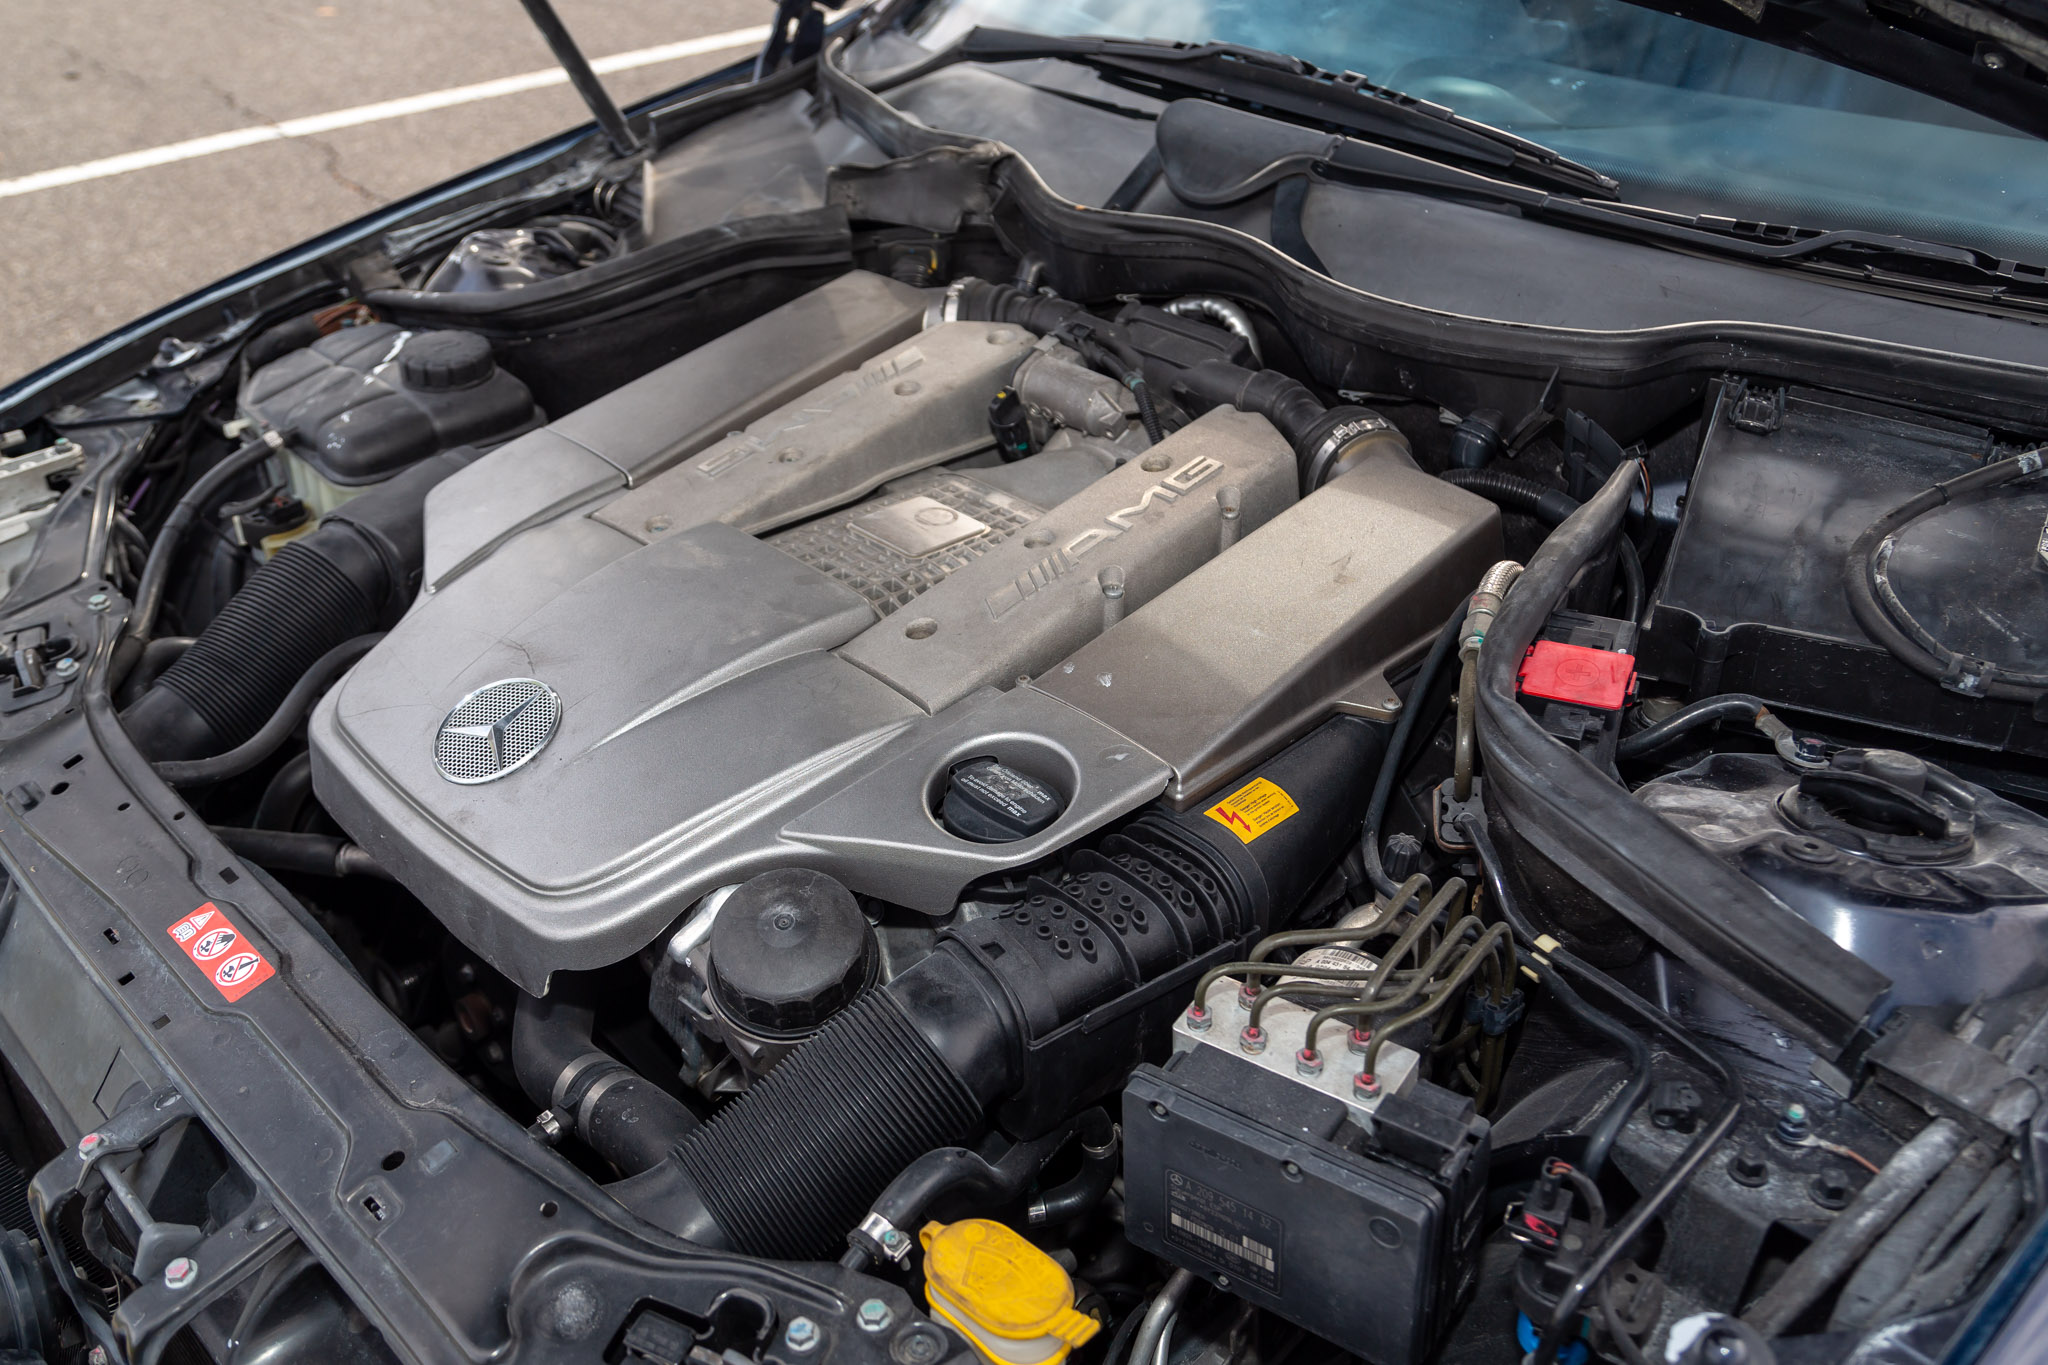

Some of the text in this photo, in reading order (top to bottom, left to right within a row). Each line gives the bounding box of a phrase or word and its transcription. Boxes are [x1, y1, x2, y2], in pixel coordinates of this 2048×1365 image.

[1058, 455, 1225, 568] AMG
[986, 785, 1006, 798] damage
[1010, 801, 1027, 813] engine
[988, 794, 1008, 807] exceed
[1007, 806, 1021, 817] max
[1185, 1181, 1192, 1191] A
